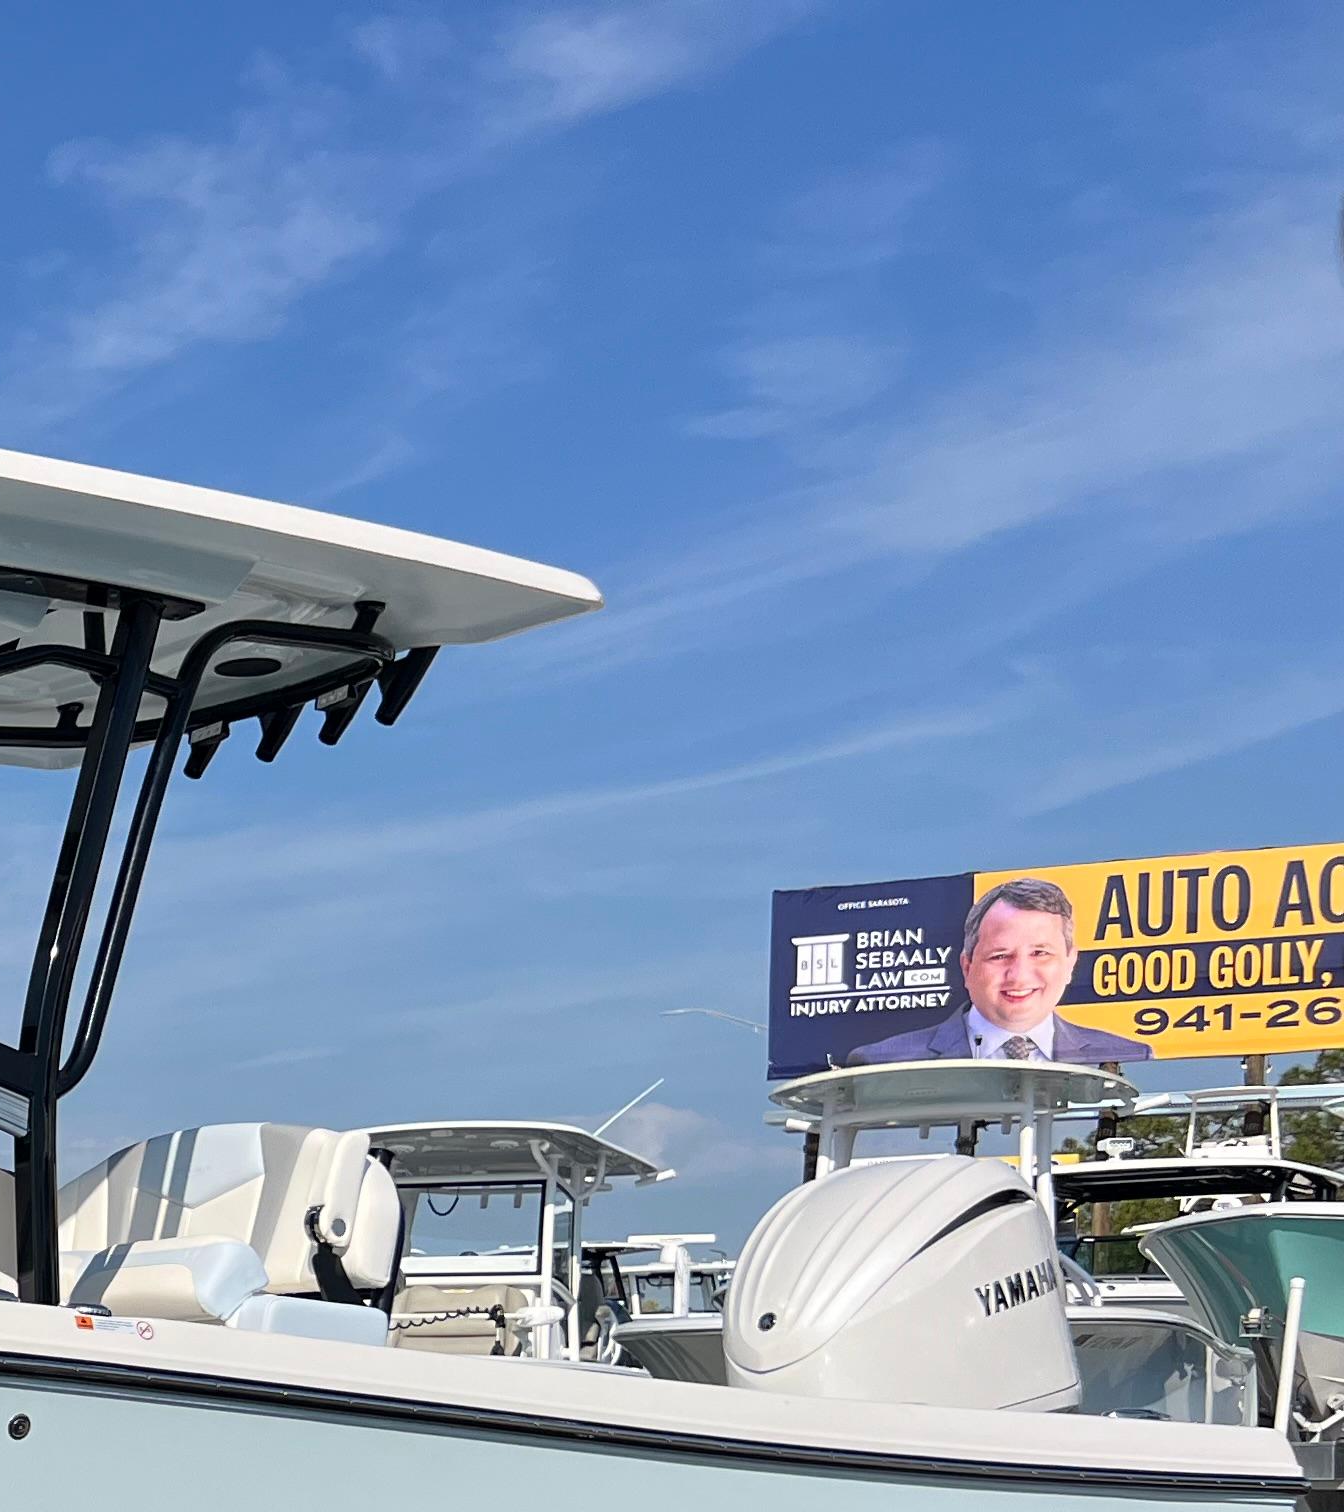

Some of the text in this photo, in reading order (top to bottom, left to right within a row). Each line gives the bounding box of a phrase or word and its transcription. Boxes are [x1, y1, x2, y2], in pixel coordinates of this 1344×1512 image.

[837, 901, 866, 911] OFFICE
[1094, 856, 1344, 941] AUTO AC
[856, 928, 924, 949] BRIAN
[855, 946, 952, 970] SEBAALY
[1092, 939, 1333, 997] GOOD GOLLY,
[855, 970, 903, 990] LAW
[790, 992, 951, 1018] INJURY ATTORNEY
[1133, 996, 1343, 1036] 941-26
[974, 1258, 1058, 1318] YAMAHA
